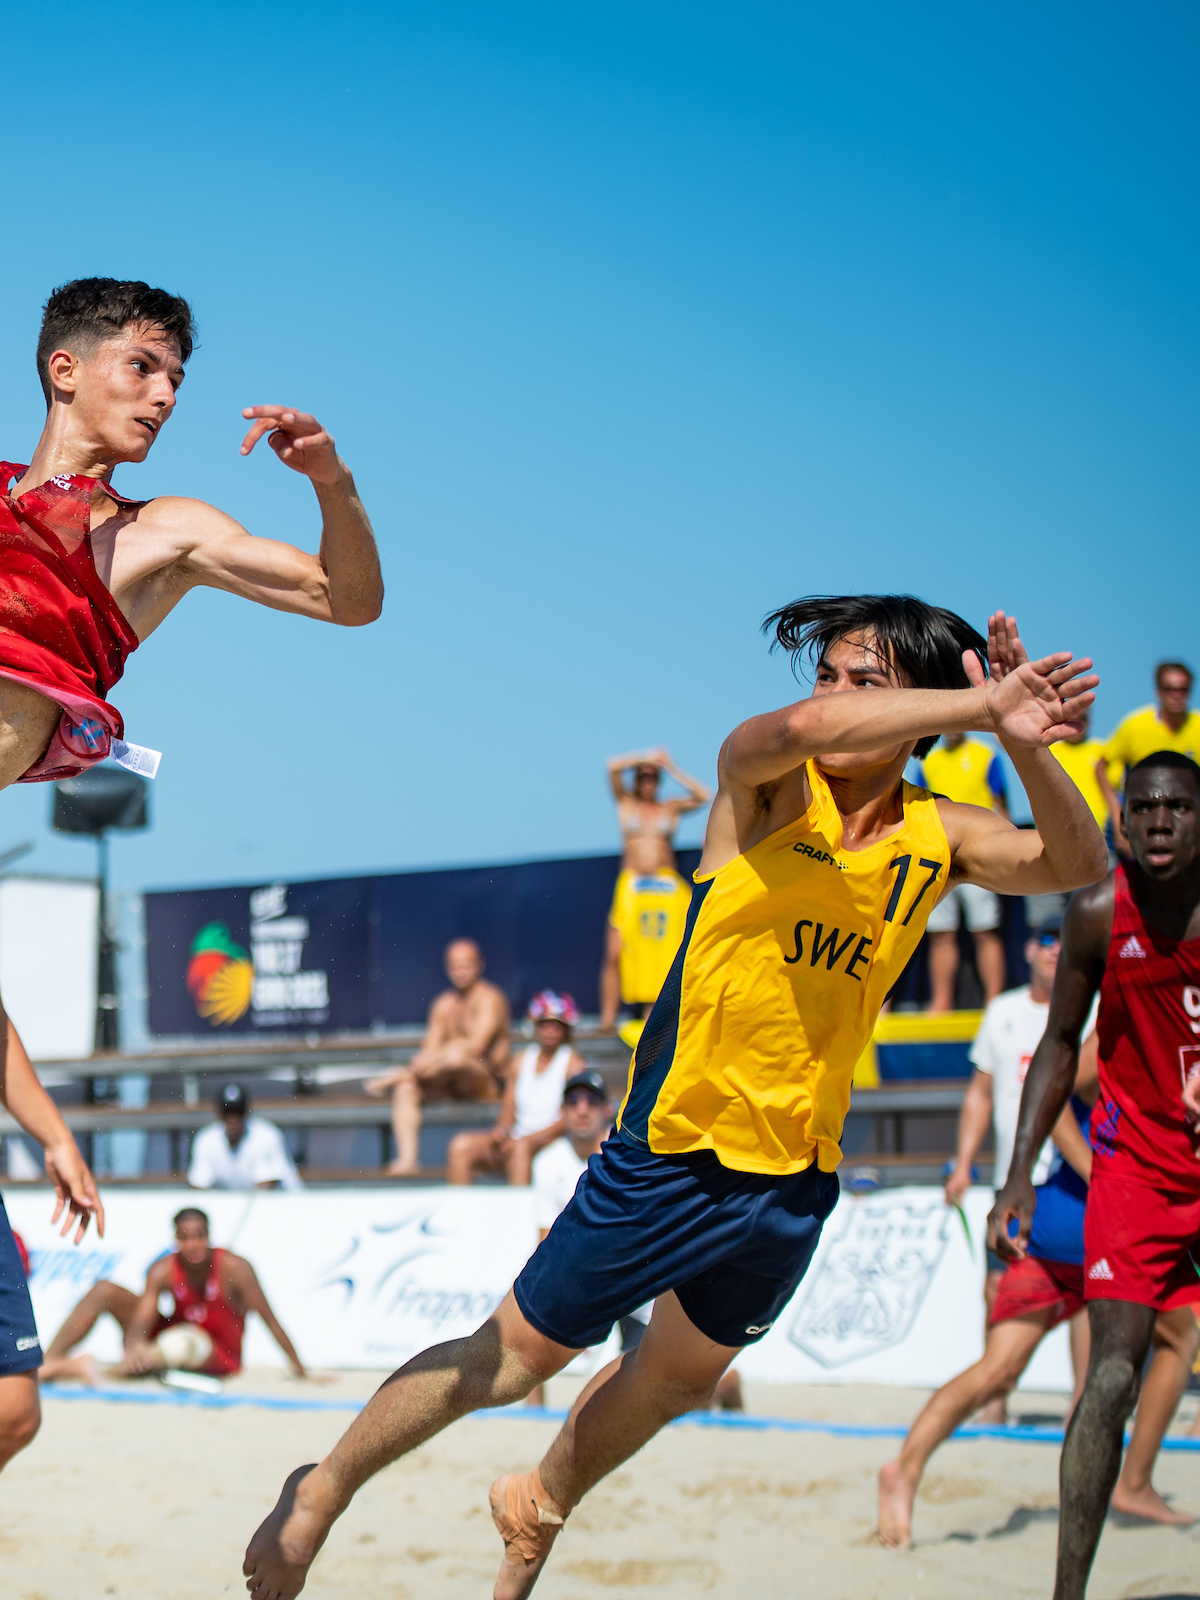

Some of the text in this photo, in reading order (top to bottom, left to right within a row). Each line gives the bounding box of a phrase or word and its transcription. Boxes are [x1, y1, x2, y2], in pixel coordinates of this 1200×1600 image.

[50, 475, 72, 491] NCE
[792, 842, 836, 866] CRAFT
[883, 854, 943, 926] 17
[783, 919, 873, 981] SWE
